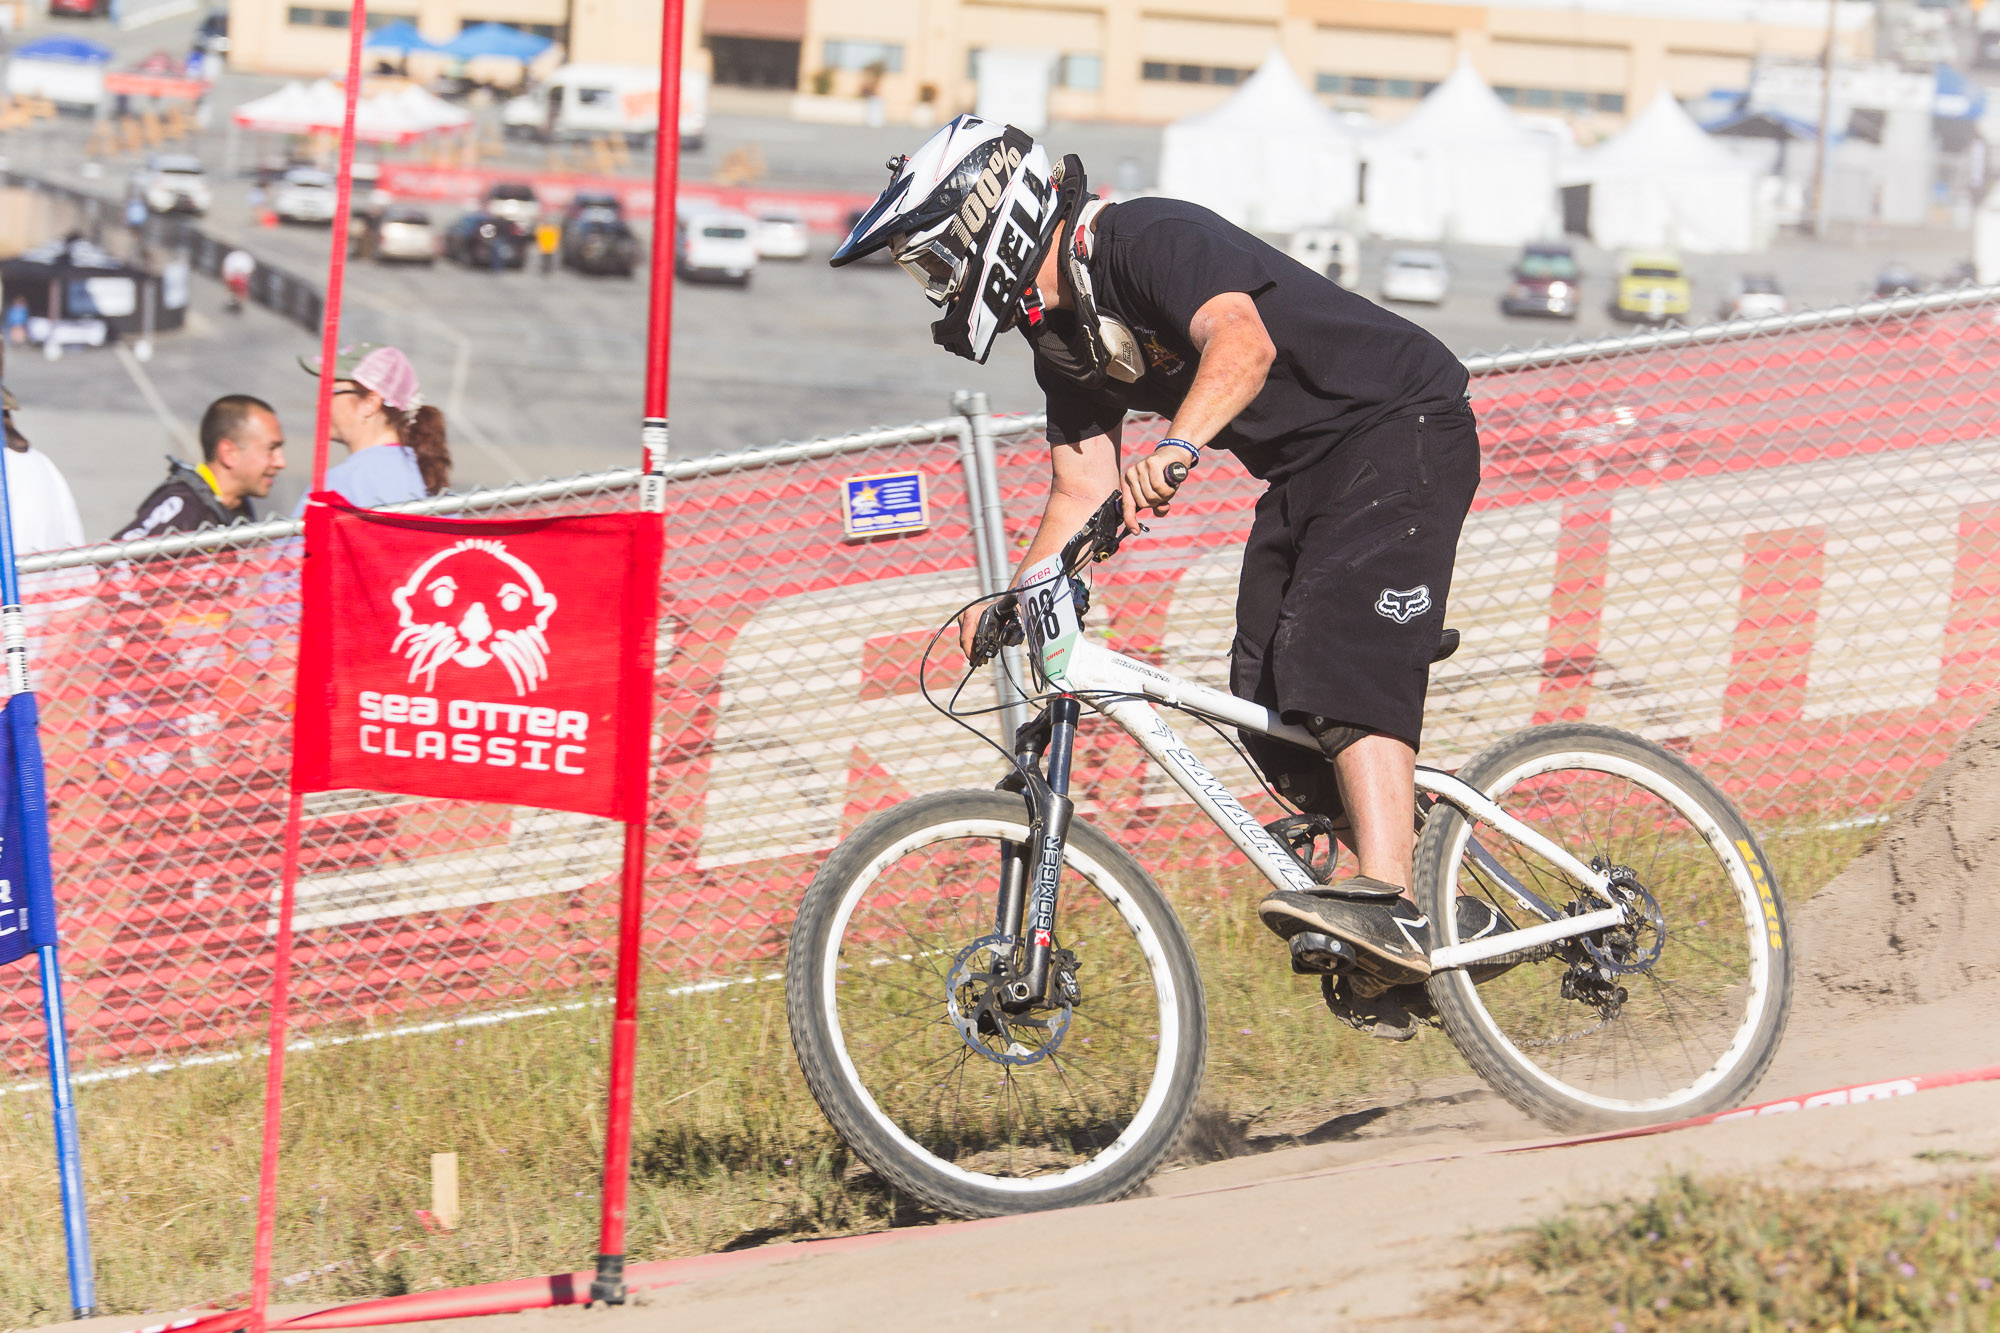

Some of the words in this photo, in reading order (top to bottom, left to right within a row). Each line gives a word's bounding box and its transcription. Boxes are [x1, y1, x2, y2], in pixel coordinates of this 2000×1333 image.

[949, 140, 1022, 249] 100%
[359, 724, 587, 776] CLASSIC
[1036, 834, 1061, 932] BOMBER
